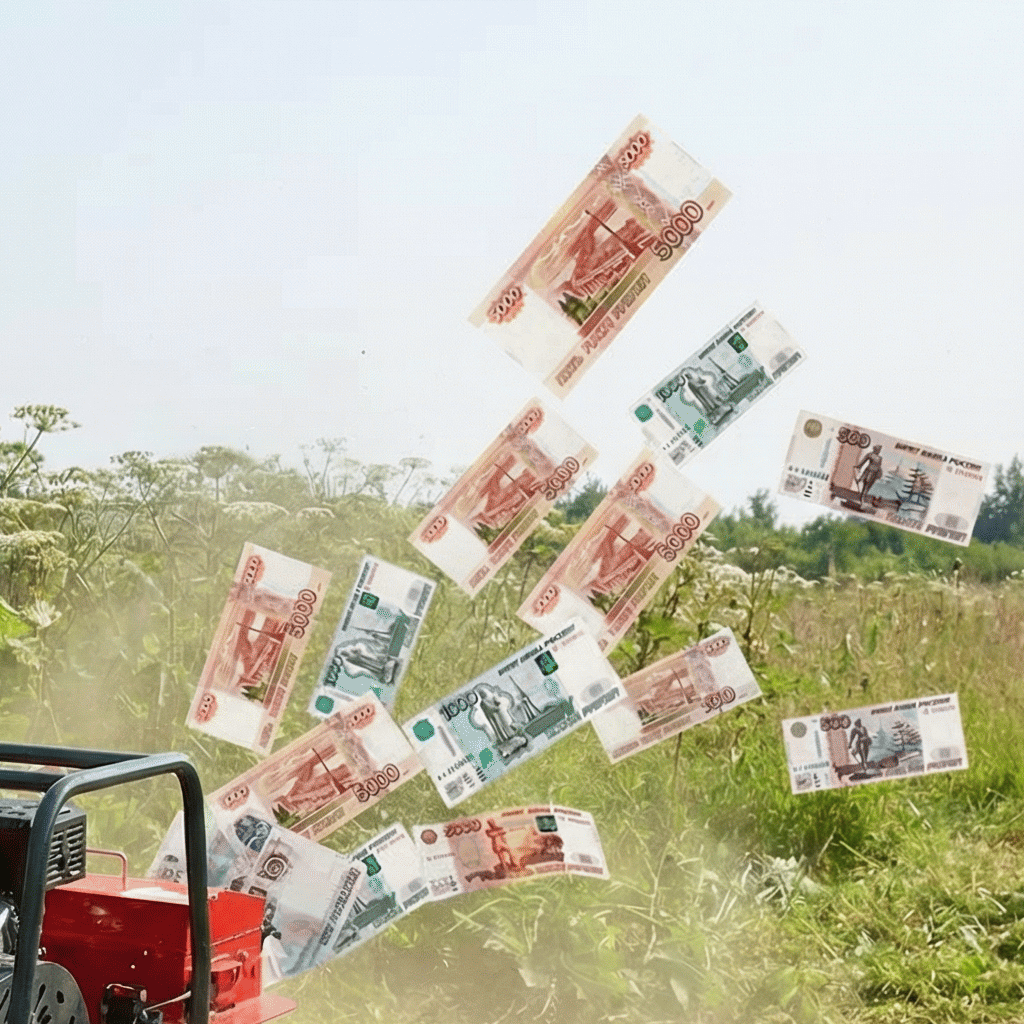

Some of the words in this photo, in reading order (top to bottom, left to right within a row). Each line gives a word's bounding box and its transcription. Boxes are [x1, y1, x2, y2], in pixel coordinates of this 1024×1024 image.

[650, 200, 704, 262] 5000
[540, 456, 580, 501] 5000
[439, 690, 479, 722] 1000
